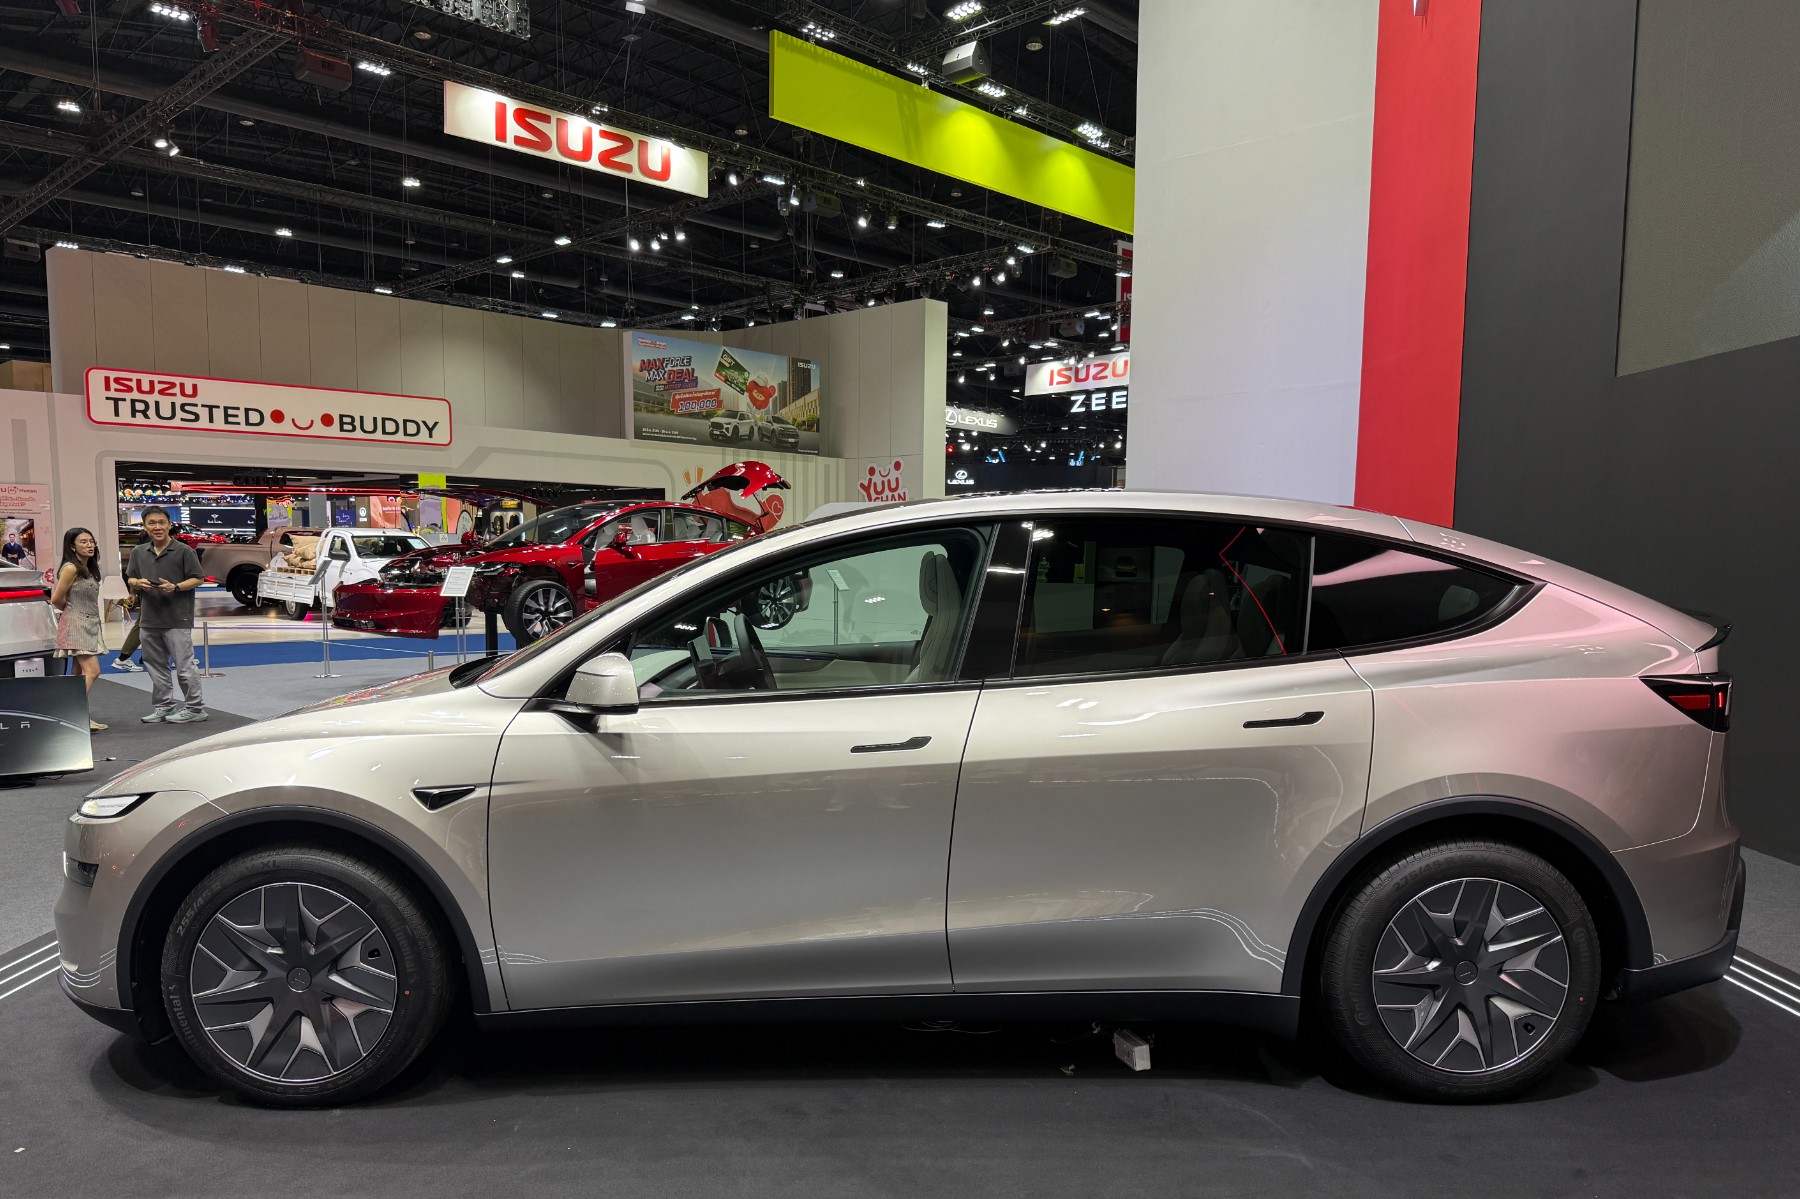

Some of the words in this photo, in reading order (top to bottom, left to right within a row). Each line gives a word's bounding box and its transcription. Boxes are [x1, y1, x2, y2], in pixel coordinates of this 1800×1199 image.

[494, 101, 672, 182] ISUZU
[639, 357, 664, 372] MAX
[722, 354, 736, 366] GIFT
[797, 362, 816, 370] ISUZU
[646, 368, 666, 382] MAX
[665, 367, 698, 383] DEAL
[1048, 359, 1129, 387] ISUZU
[103, 375, 199, 399] ISUZU
[1070, 390, 1128, 413] ZEE
[104, 396, 265, 428] TRUSTED
[338, 413, 440, 439] BUDDY
[957, 414, 998, 429] LEXUS
[859, 476, 900, 502] YUU
